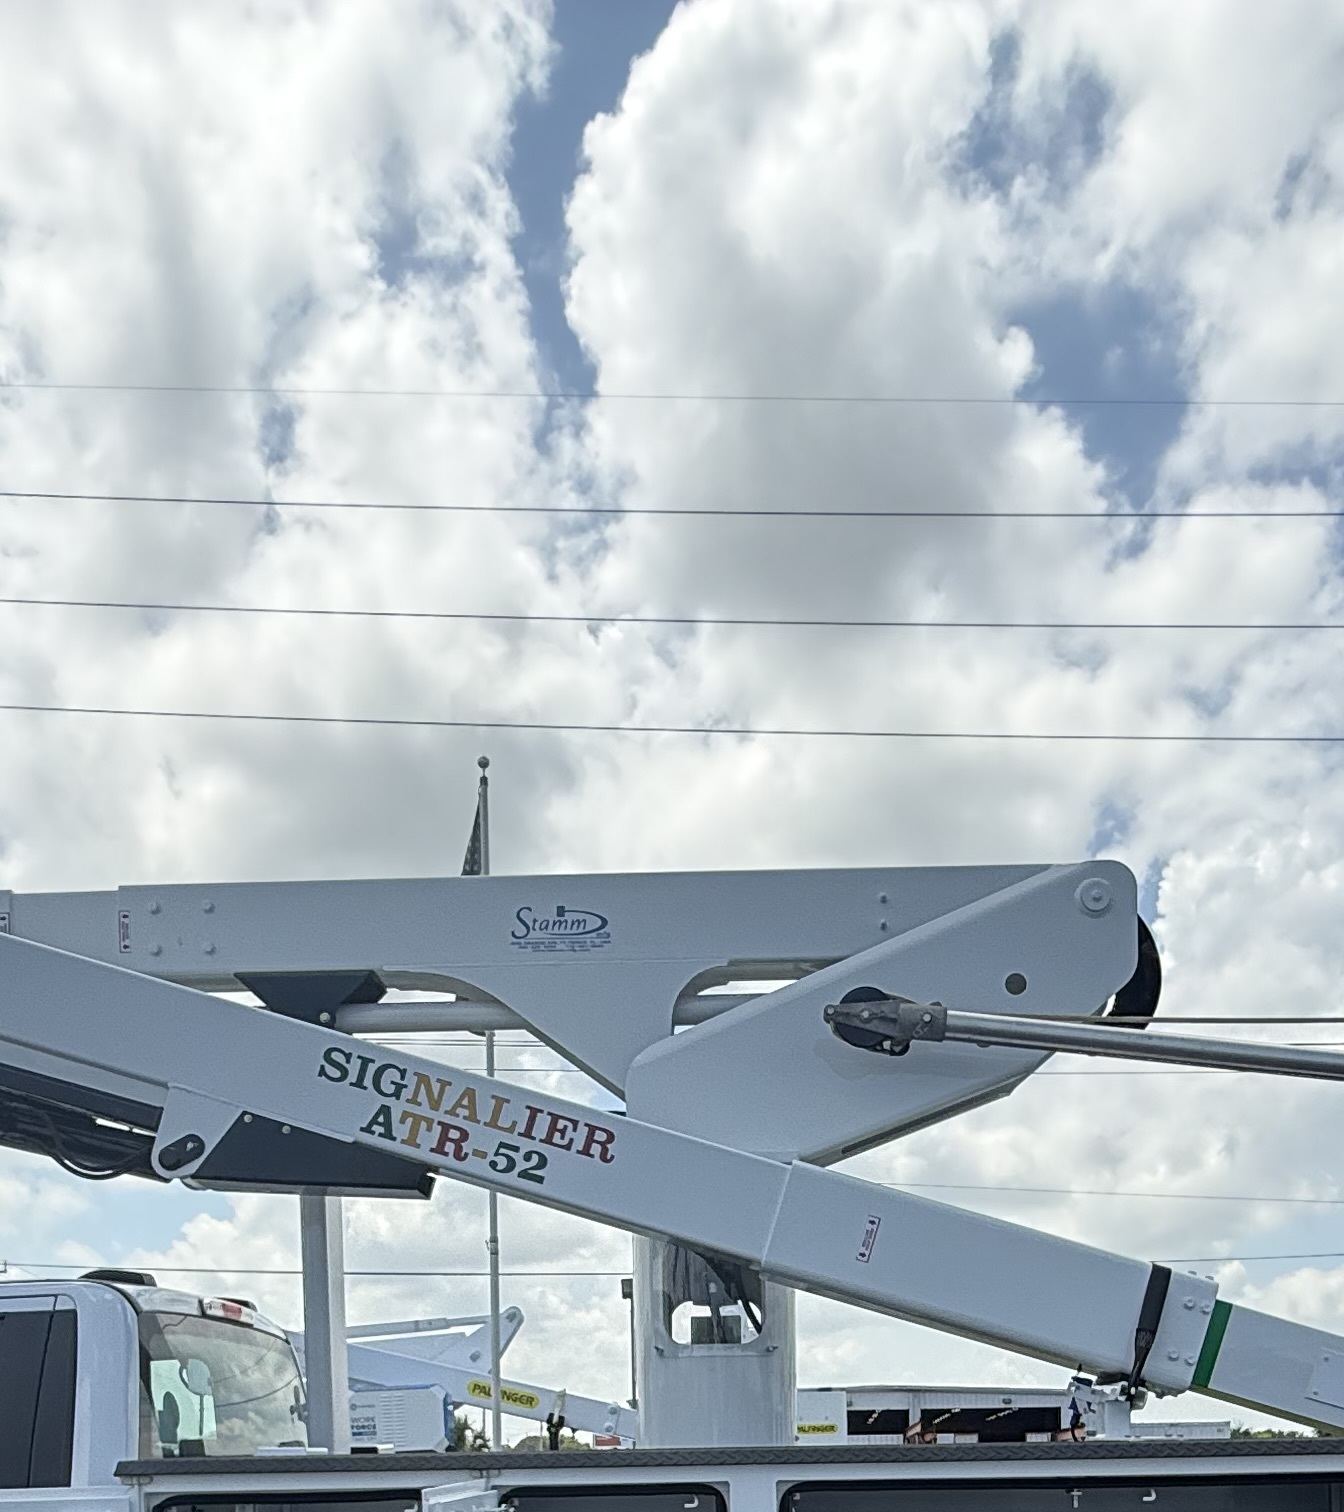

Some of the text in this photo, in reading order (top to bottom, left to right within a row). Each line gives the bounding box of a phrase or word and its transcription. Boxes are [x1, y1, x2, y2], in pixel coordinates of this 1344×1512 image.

[511, 906, 587, 940] Stamm
[317, 1046, 617, 1164] SIGNALIER
[359, 1103, 549, 1185] ATR-52
[471, 1383, 535, 1408] PALNGER
